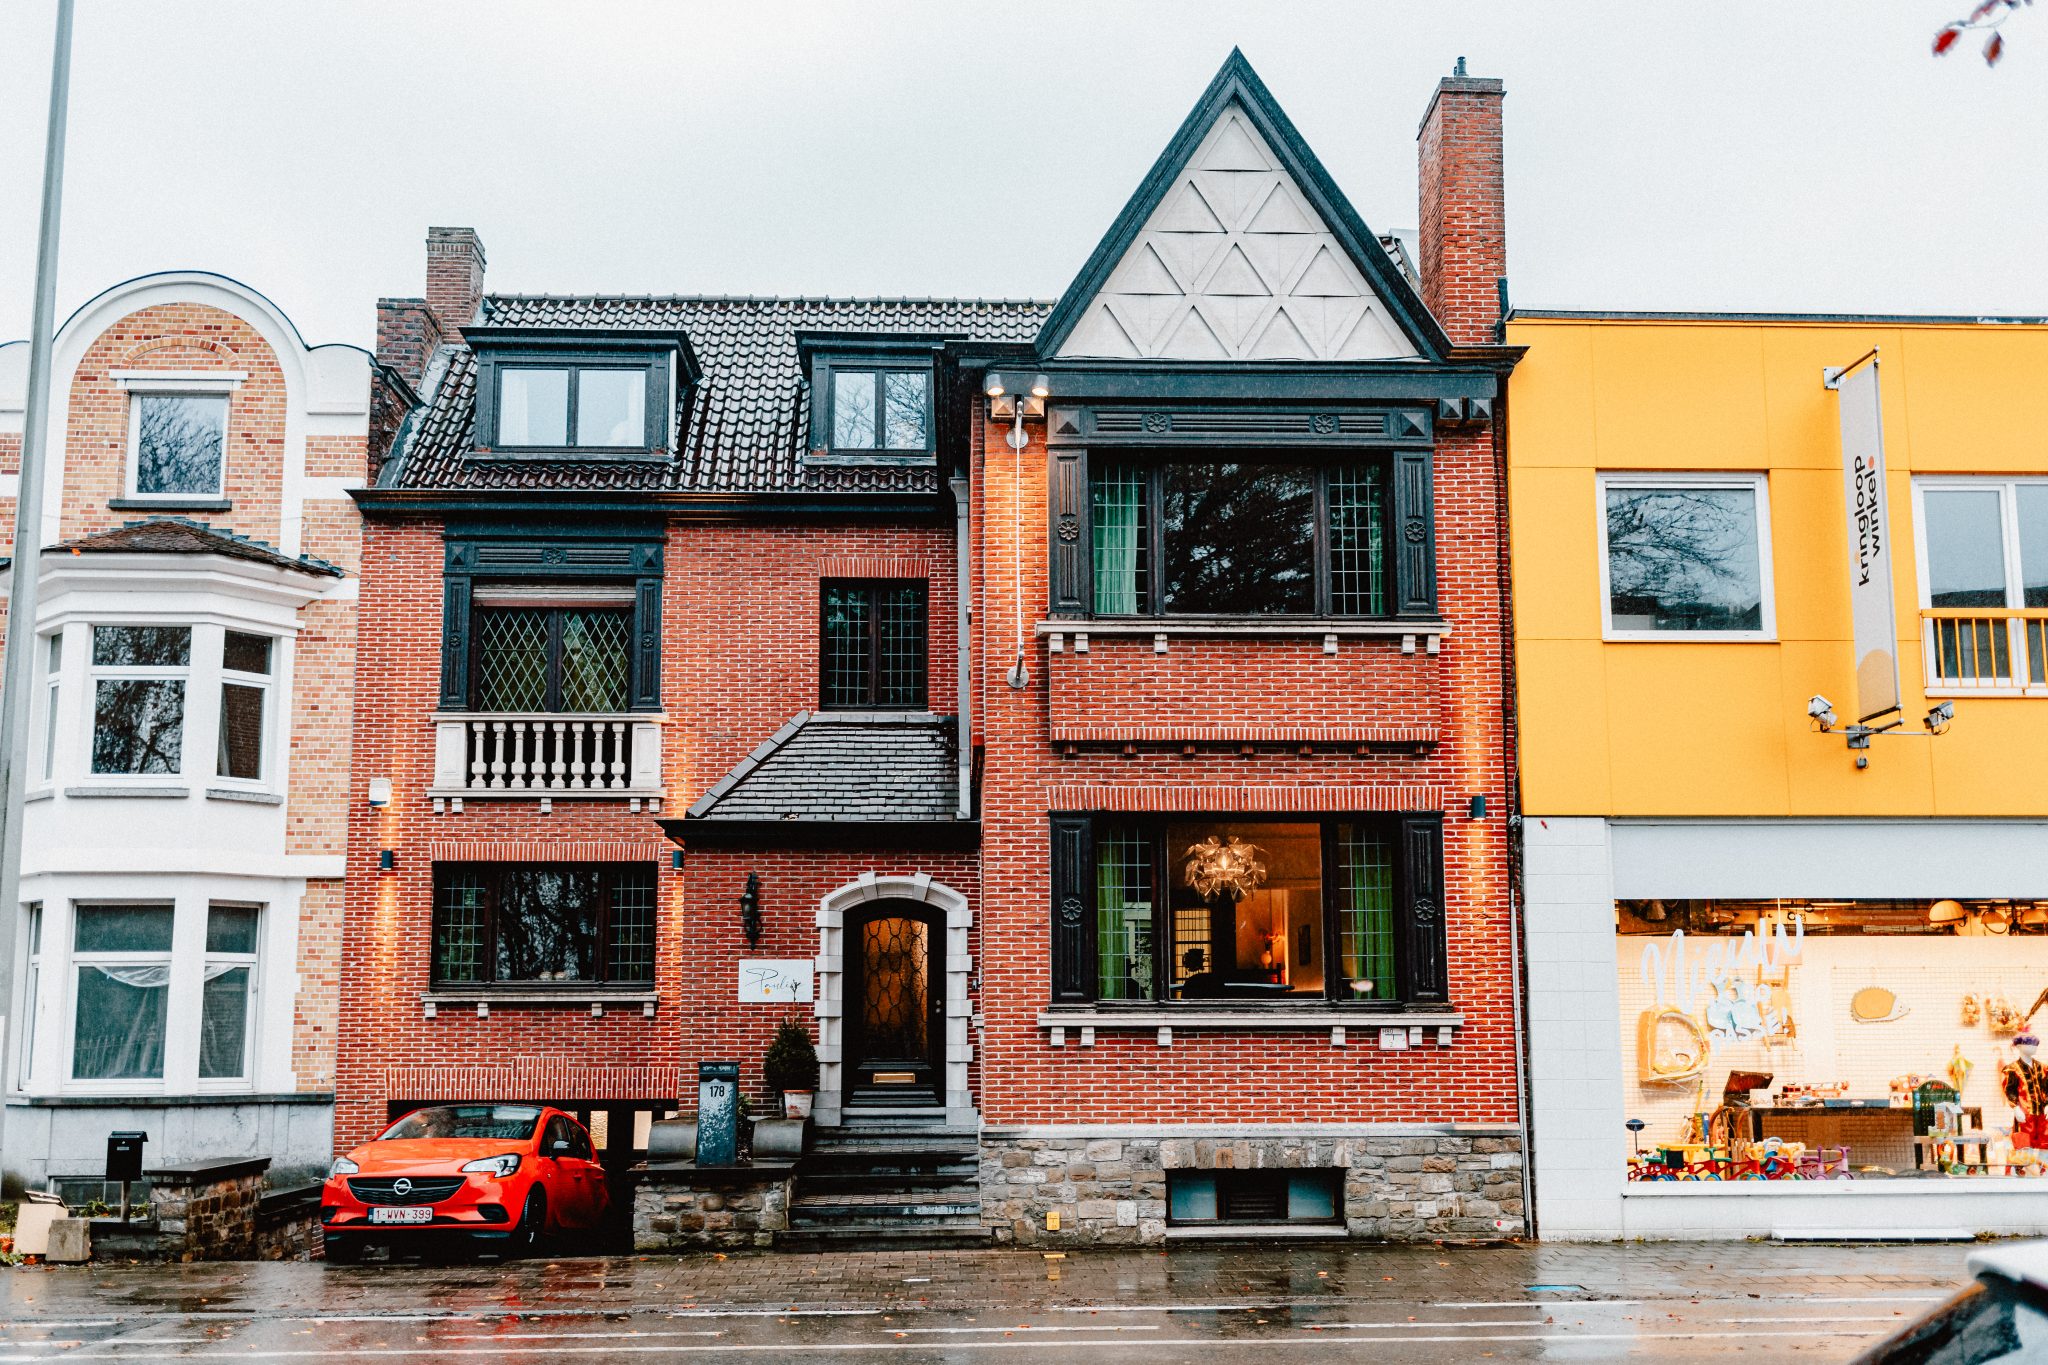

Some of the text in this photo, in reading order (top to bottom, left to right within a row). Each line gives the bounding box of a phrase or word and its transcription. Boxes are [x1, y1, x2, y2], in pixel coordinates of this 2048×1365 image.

[1854, 456, 1870, 587] kringloop
[1864, 469, 1880, 559] winkel
[709, 1085, 725, 1097] 178
[376, 1209, 431, 1220] 1-WVN-399
